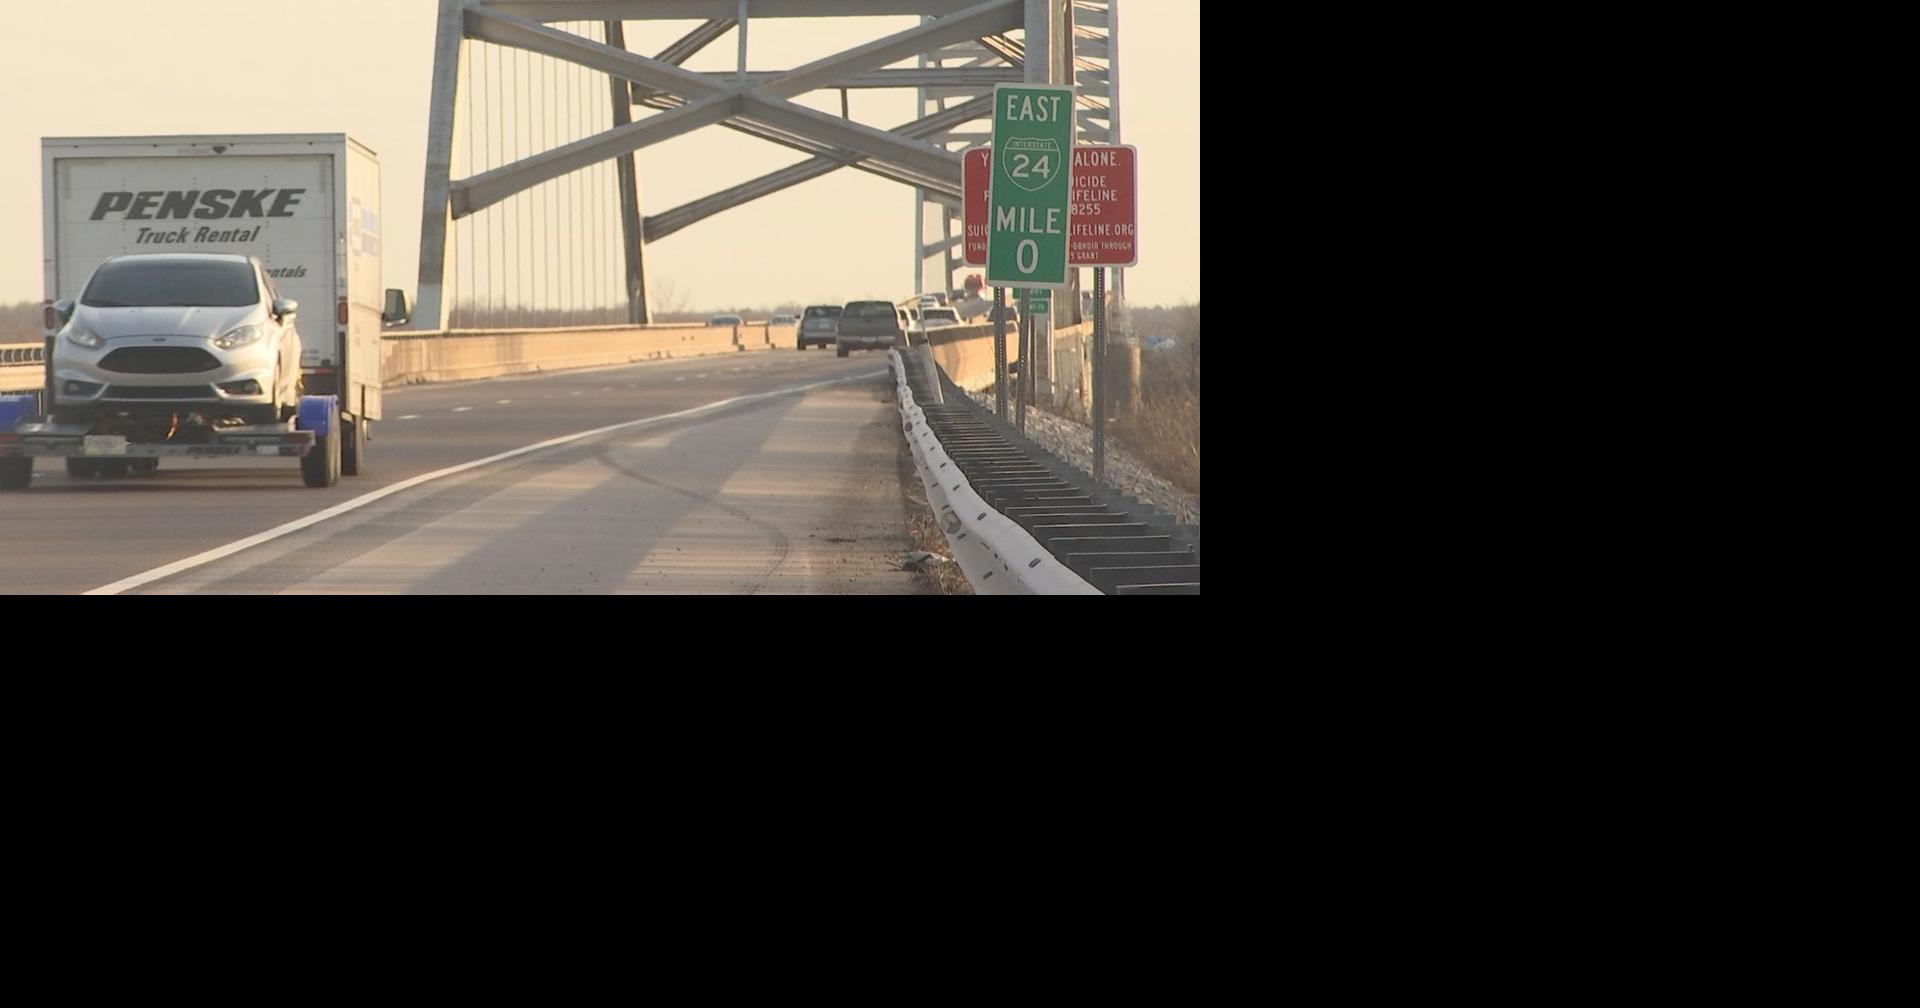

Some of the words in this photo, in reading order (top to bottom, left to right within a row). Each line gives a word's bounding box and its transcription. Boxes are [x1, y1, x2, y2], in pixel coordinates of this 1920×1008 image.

[1006, 94, 1061, 122] EAST
[1012, 140, 1052, 149] INTERSTATE
[1012, 153, 1050, 179] 24
[1074, 151, 1121, 167] ALONE.
[1072, 175, 1107, 188] ICIDE
[1072, 189, 1118, 201] IFELINE
[89, 188, 306, 221] PENSKE
[1071, 203, 1101, 216] 8255
[996, 205, 1061, 235] MILE
[136, 226, 189, 244] Truck
[194, 225, 260, 243] Rental
[1070, 223, 1134, 236] IFELINE.ORG
[1016, 238, 1039, 274] 0
